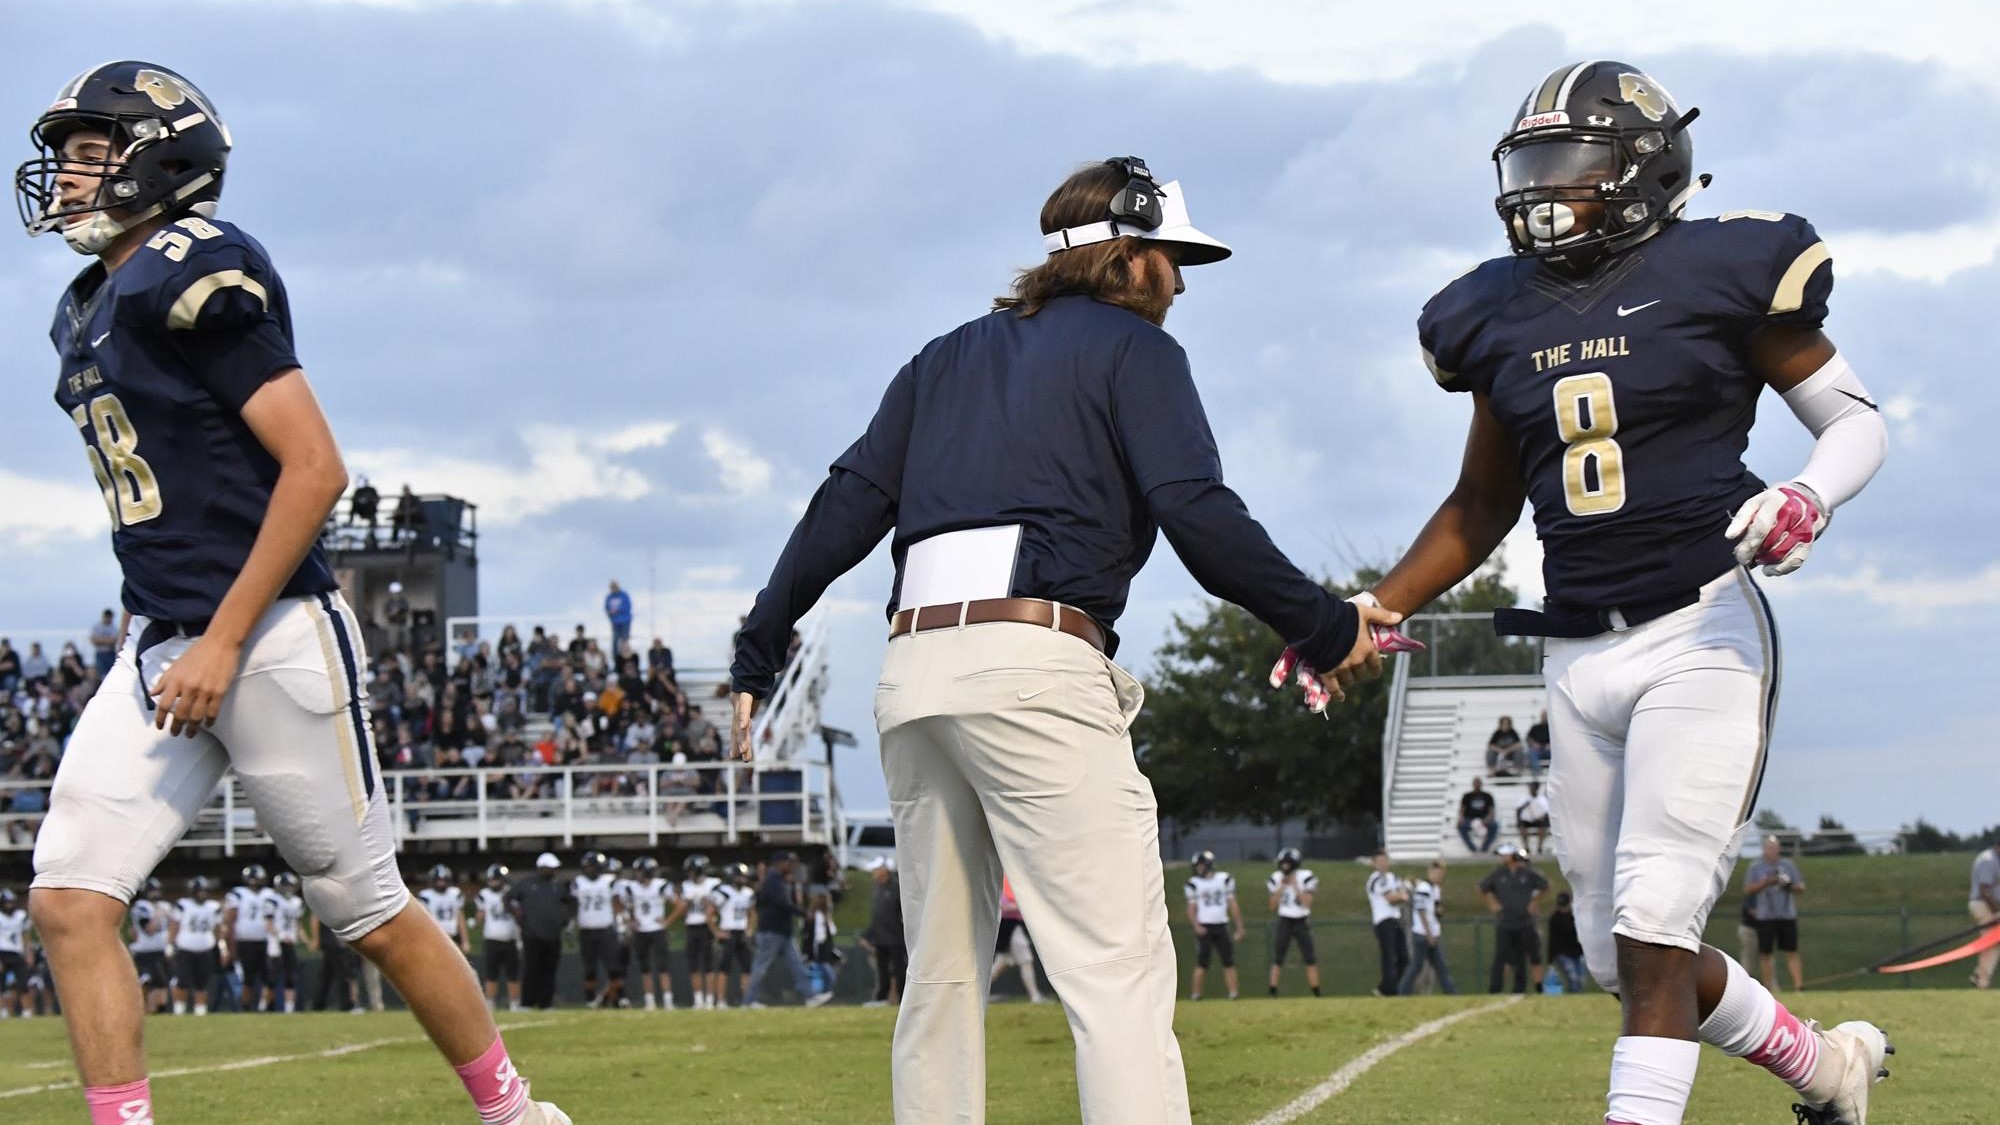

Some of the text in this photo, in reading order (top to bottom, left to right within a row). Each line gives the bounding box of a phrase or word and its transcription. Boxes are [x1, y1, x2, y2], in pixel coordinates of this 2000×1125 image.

[1521, 113, 1561, 129] Riddell
[1134, 193, 1148, 211] P
[145, 216, 225, 262] 58
[1531, 335, 1630, 372] THE HALL
[1553, 371, 1626, 516] 8
